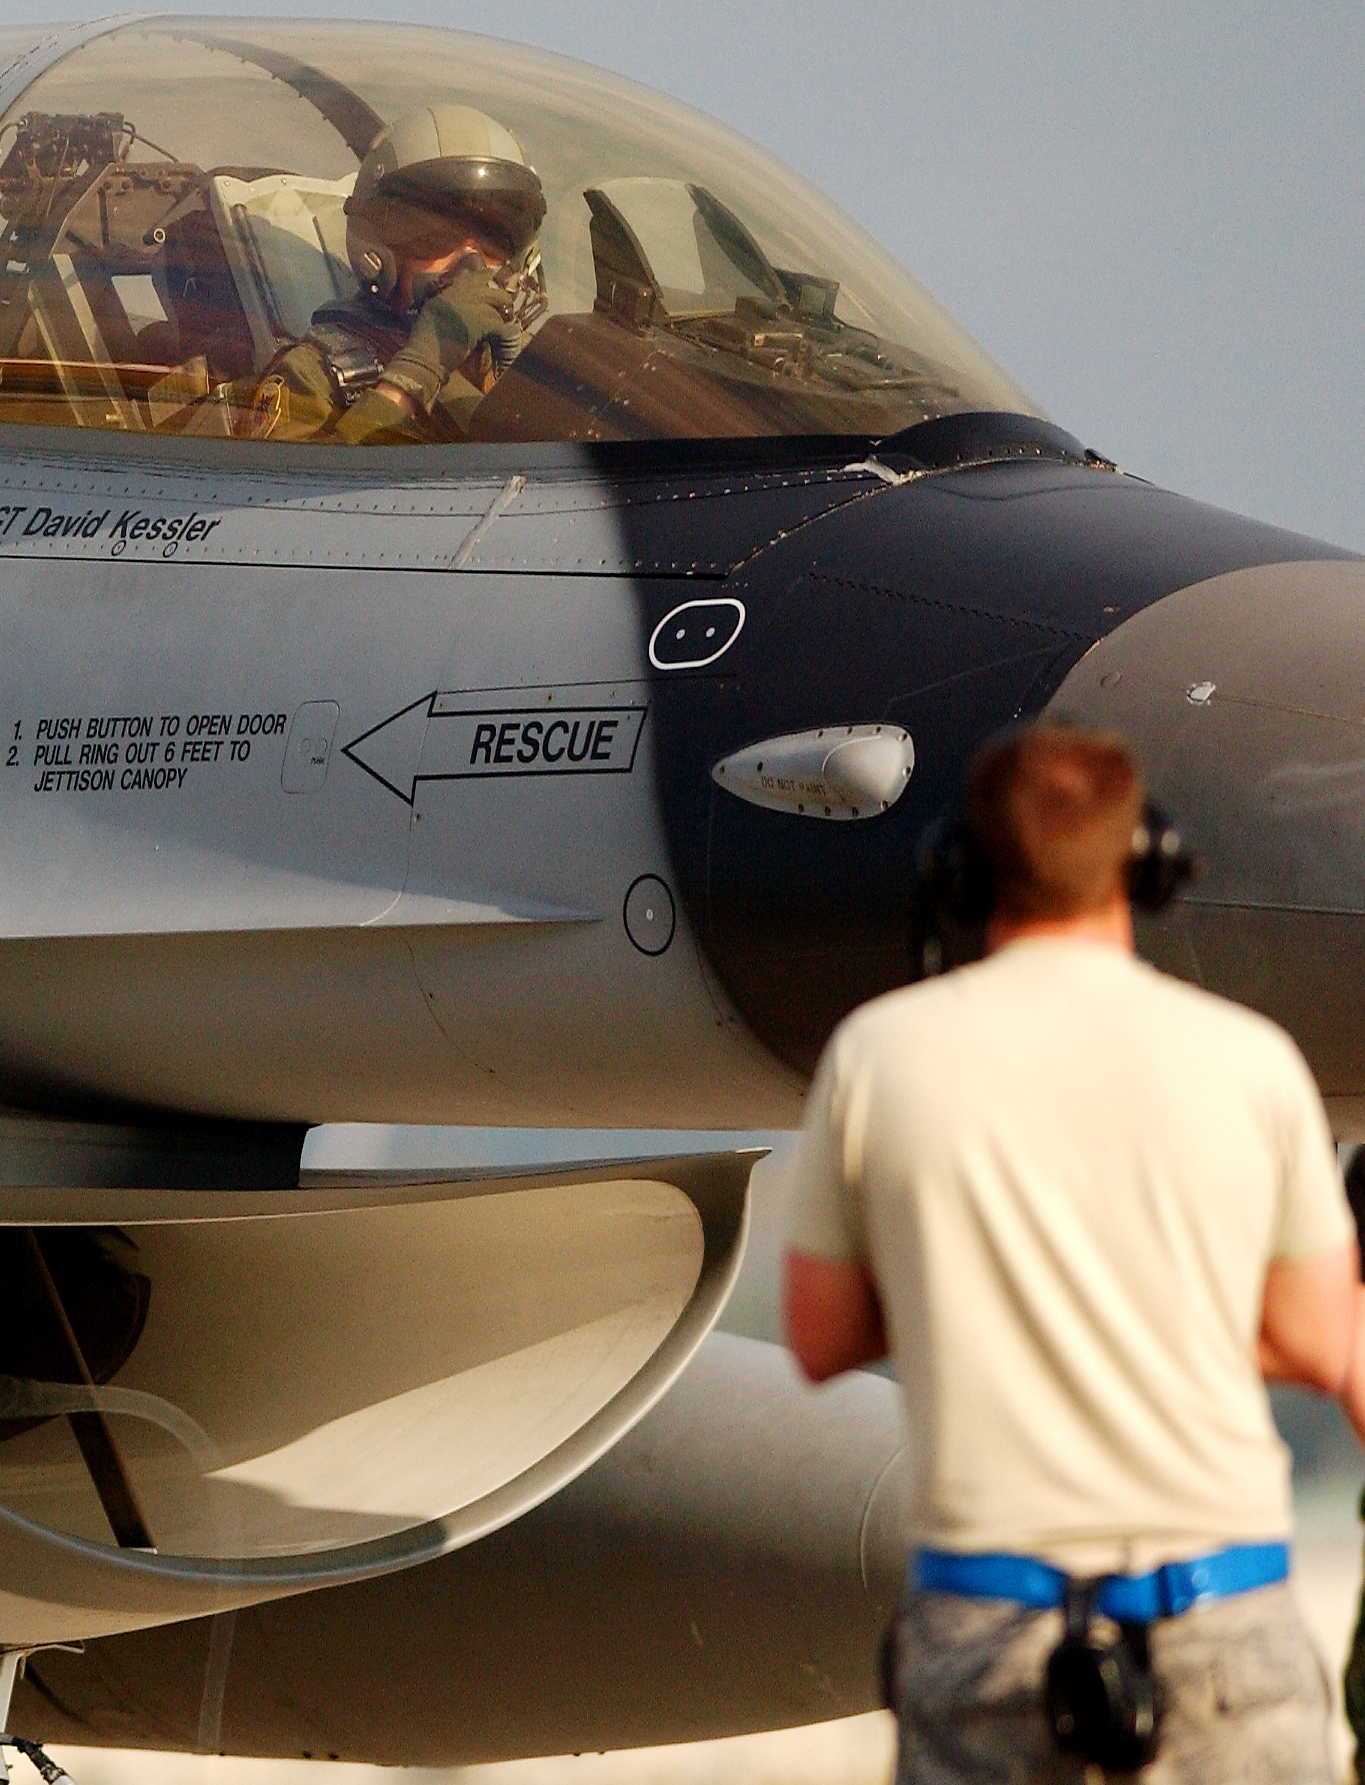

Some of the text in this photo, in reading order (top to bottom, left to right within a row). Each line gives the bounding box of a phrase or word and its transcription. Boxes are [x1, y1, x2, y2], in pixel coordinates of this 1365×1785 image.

[23, 508, 110, 538] David
[109, 510, 221, 541] Kessler
[14, 713, 287, 740] 1. PUSH BUTTON TO OPEN DOOR
[6, 739, 251, 767] 2. PULL RING OUT 6 FEET TO
[470, 720, 619, 764] RESCUE
[34, 768, 188, 792] JETTISON CANOPY
